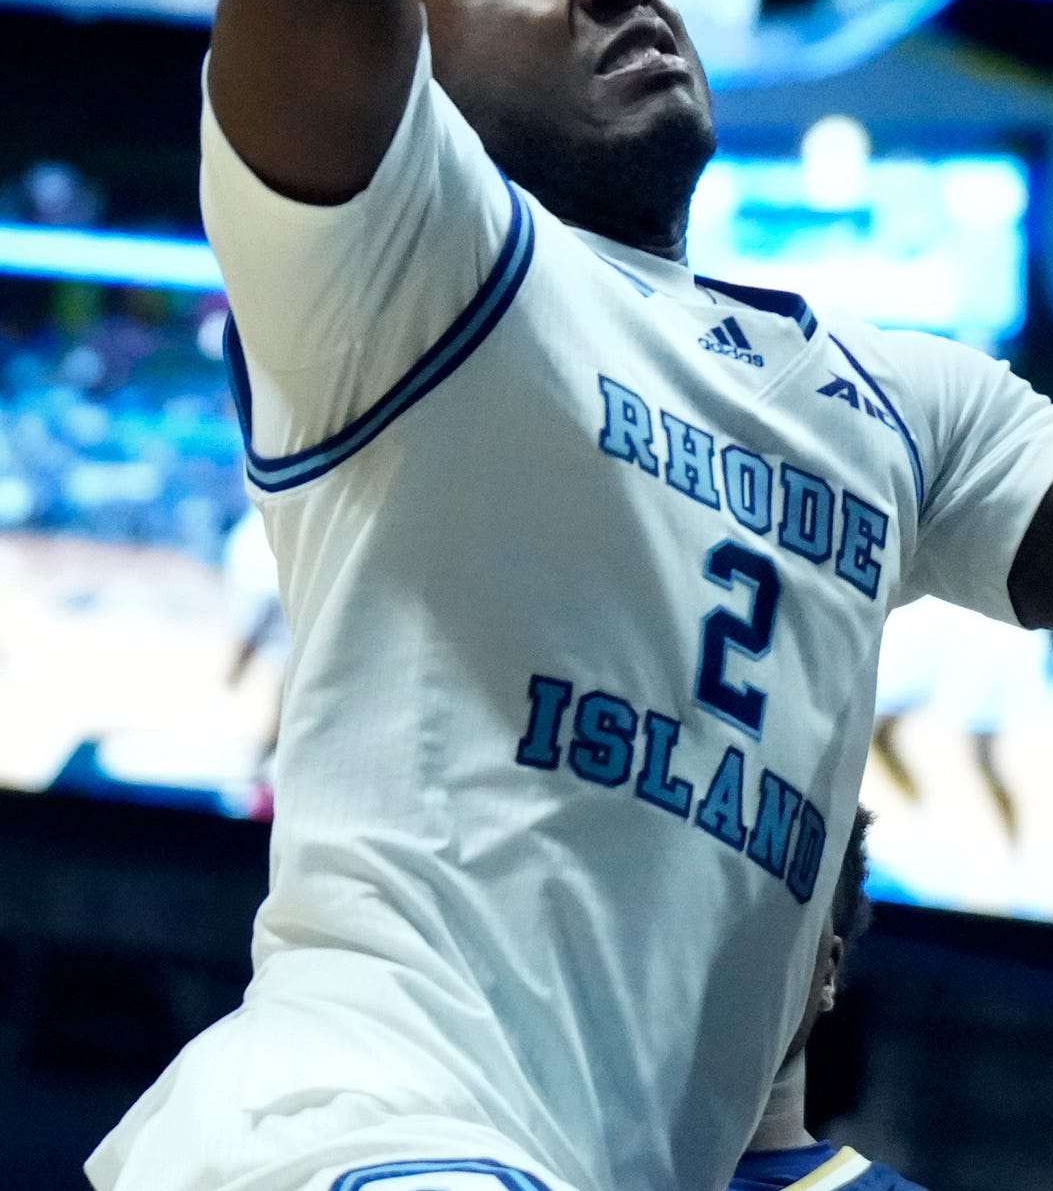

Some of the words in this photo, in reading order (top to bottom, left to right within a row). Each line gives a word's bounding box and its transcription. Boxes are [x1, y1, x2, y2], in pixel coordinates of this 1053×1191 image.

[698, 336, 765, 368] adidas
[598, 373, 888, 600] RHODE
[697, 538, 780, 742] 2
[516, 674, 826, 905] ISLAND
